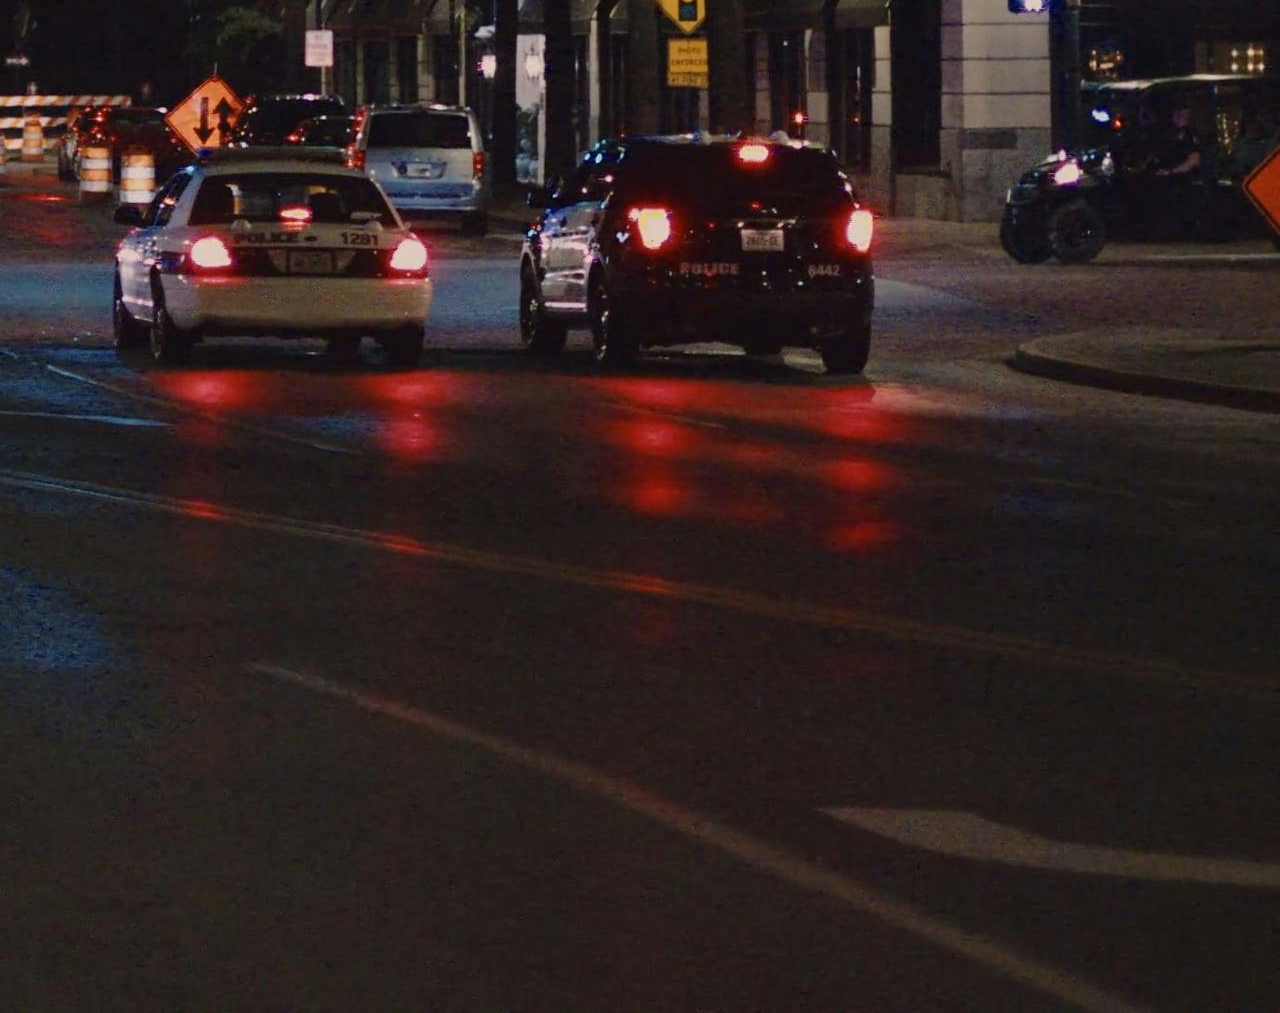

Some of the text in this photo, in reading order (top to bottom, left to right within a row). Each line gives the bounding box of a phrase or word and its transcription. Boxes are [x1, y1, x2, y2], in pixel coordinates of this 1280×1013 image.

[234, 231, 300, 245] POLICE
[341, 232, 380, 245] 1281
[680, 262, 739, 276] POLICE
[808, 263, 841, 277] 6442
